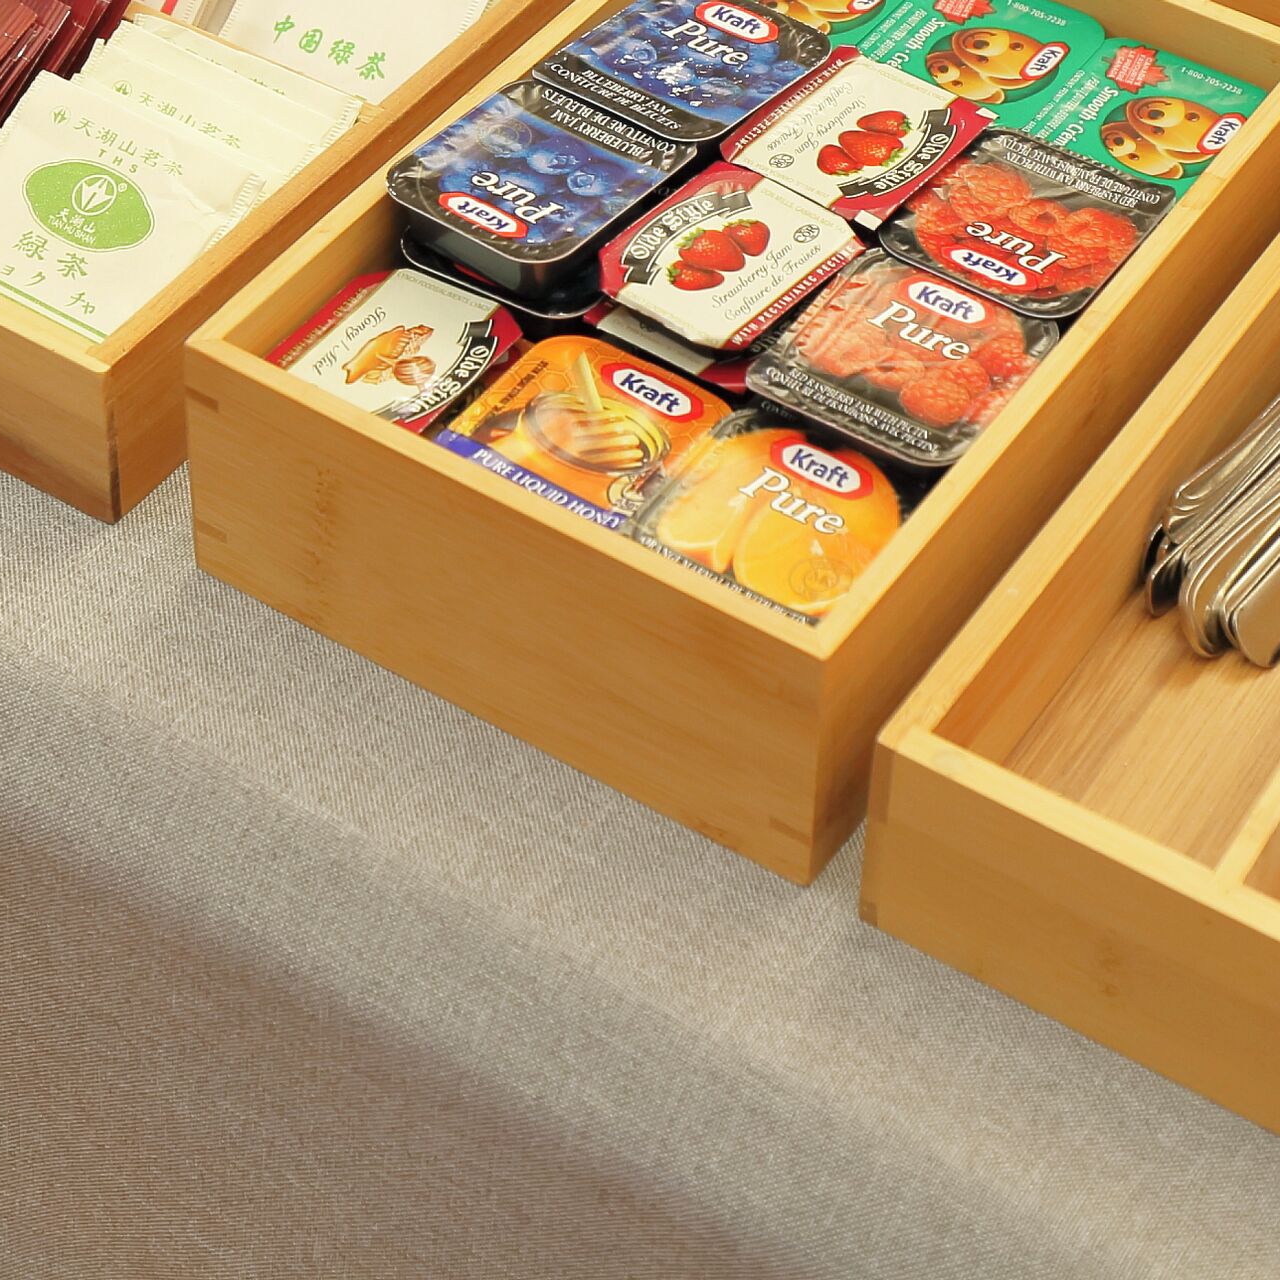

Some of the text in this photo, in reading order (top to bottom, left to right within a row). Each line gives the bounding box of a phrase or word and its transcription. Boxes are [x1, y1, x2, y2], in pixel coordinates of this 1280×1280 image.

[663, 19, 750, 68] Pure
[710, 7, 761, 36] Kraft
[905, 17, 946, 51] Smooth
[1029, 48, 1062, 73] Kraft
[1180, 65, 1244, 96] 1-800-705-7238
[551, 63, 616, 99] CONFITURE
[613, 94, 633, 107] DE
[582, 69, 673, 116] BLUEBERRY JAM
[1080, 85, 1120, 122] Smooth
[541, 88, 677, 153] CONFITURE DE BLEUETS
[550, 108, 651, 159] BLUEBERRY JAM
[733, 118, 771, 151] PECTINE
[794, 94, 867, 156] Strawberry Jam
[800, 113, 813, 126] de
[1207, 119, 1239, 146] Kraft
[873, 132, 948, 193] Olde Style
[992, 134, 1161, 205] CONFITURE DE FRAMBOISES AVEC PECTINE
[1002, 150, 1138, 208] RED RASPBERRY JAM WITH PECTIN
[456, 201, 509, 231] Kraft
[470, 168, 565, 226] Pure
[631, 198, 716, 261] Olde Style
[794, 224, 820, 242] COR
[965, 220, 1067, 274] Pure
[711, 242, 794, 310] Strawberry Jam
[723, 244, 823, 323] Confiture de Fraises
[962, 252, 1019, 283] Kraft
[731, 245, 856, 348] WITH PECTIN/AVEC PECTINE
[915, 286, 977, 321] Kraft
[343, 305, 387, 342] Honey
[869, 300, 971, 361] Pure
[311, 344, 340, 376] Miel
[454, 345, 489, 380] Olde
[618, 372, 681, 413] Kraft
[473, 448, 514, 476] PURE
[512, 470, 569, 507] LIQUID
[787, 448, 851, 488] Kraft
[738, 467, 846, 535] Pure
